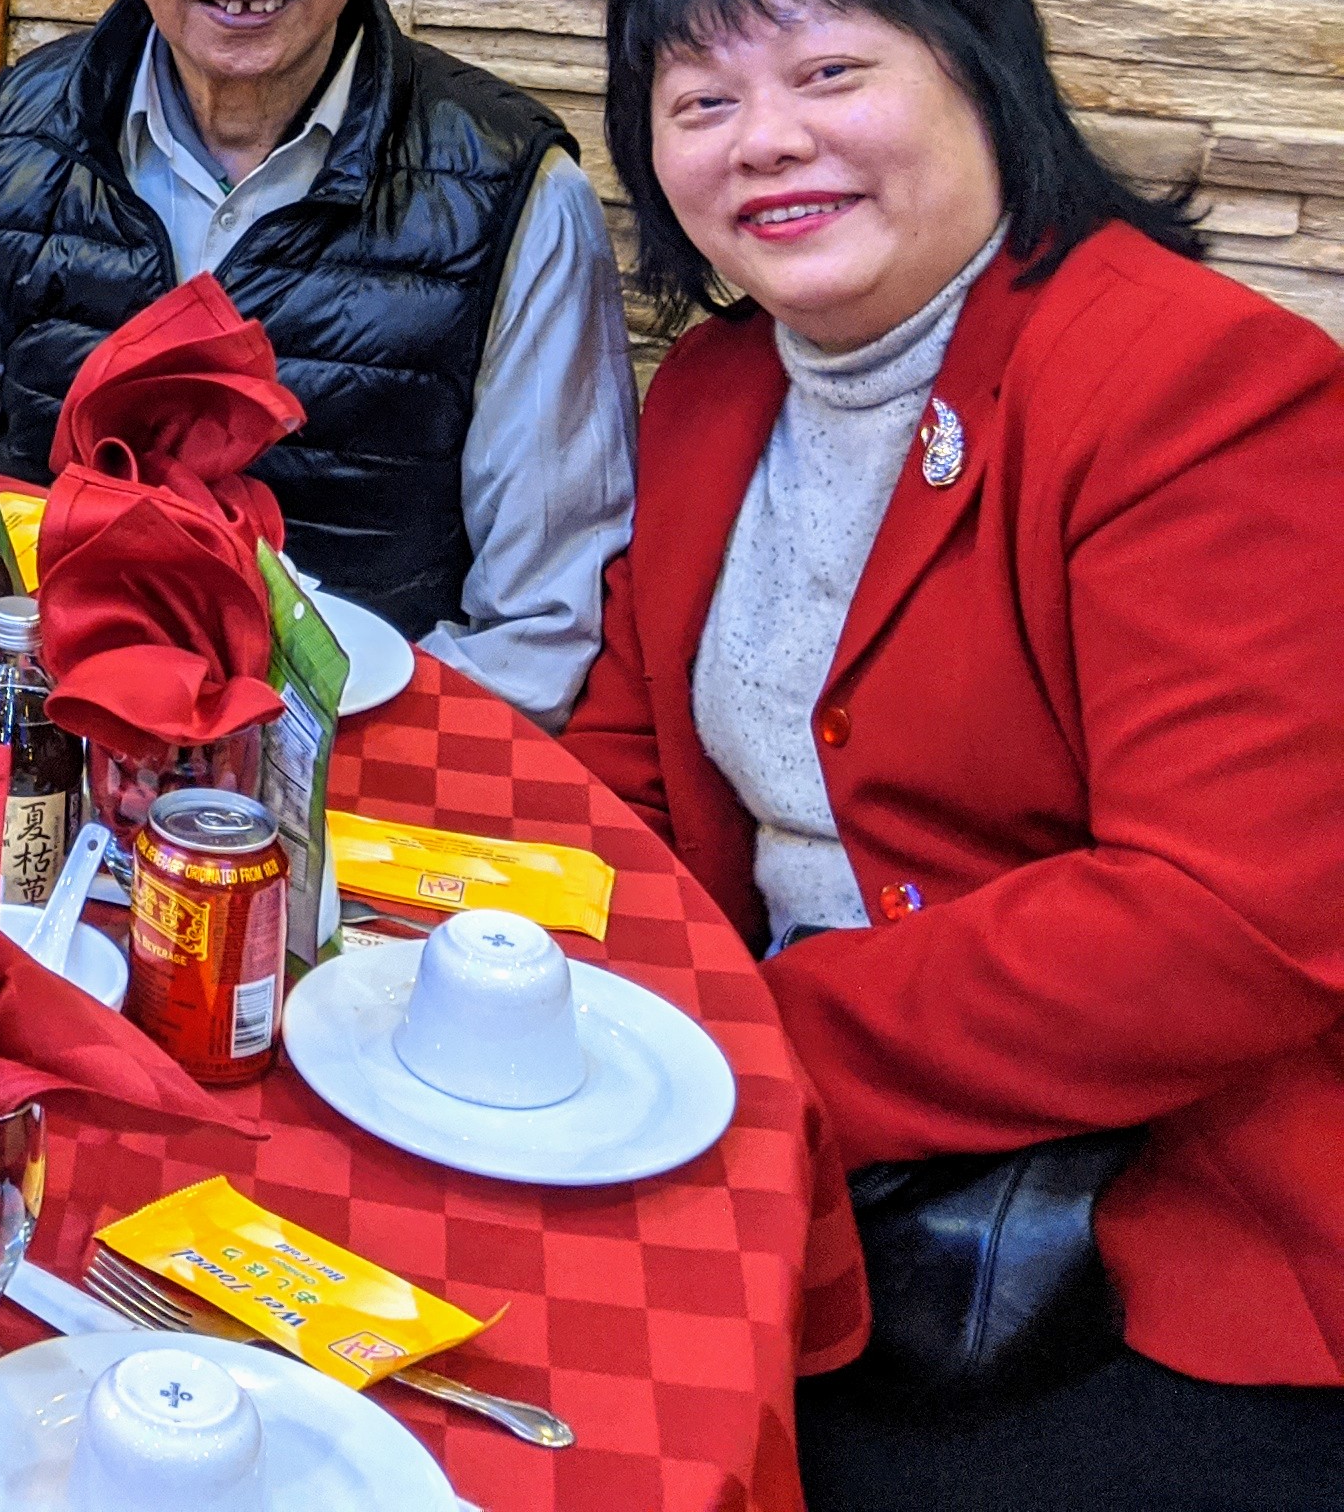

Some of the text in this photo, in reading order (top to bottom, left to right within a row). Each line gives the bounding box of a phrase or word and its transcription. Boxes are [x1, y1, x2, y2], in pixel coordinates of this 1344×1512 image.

[185, 864, 238, 886] ORIGINATED
[239, 864, 263, 883] FROM
[170, 1248, 306, 1328] Wet Towel
